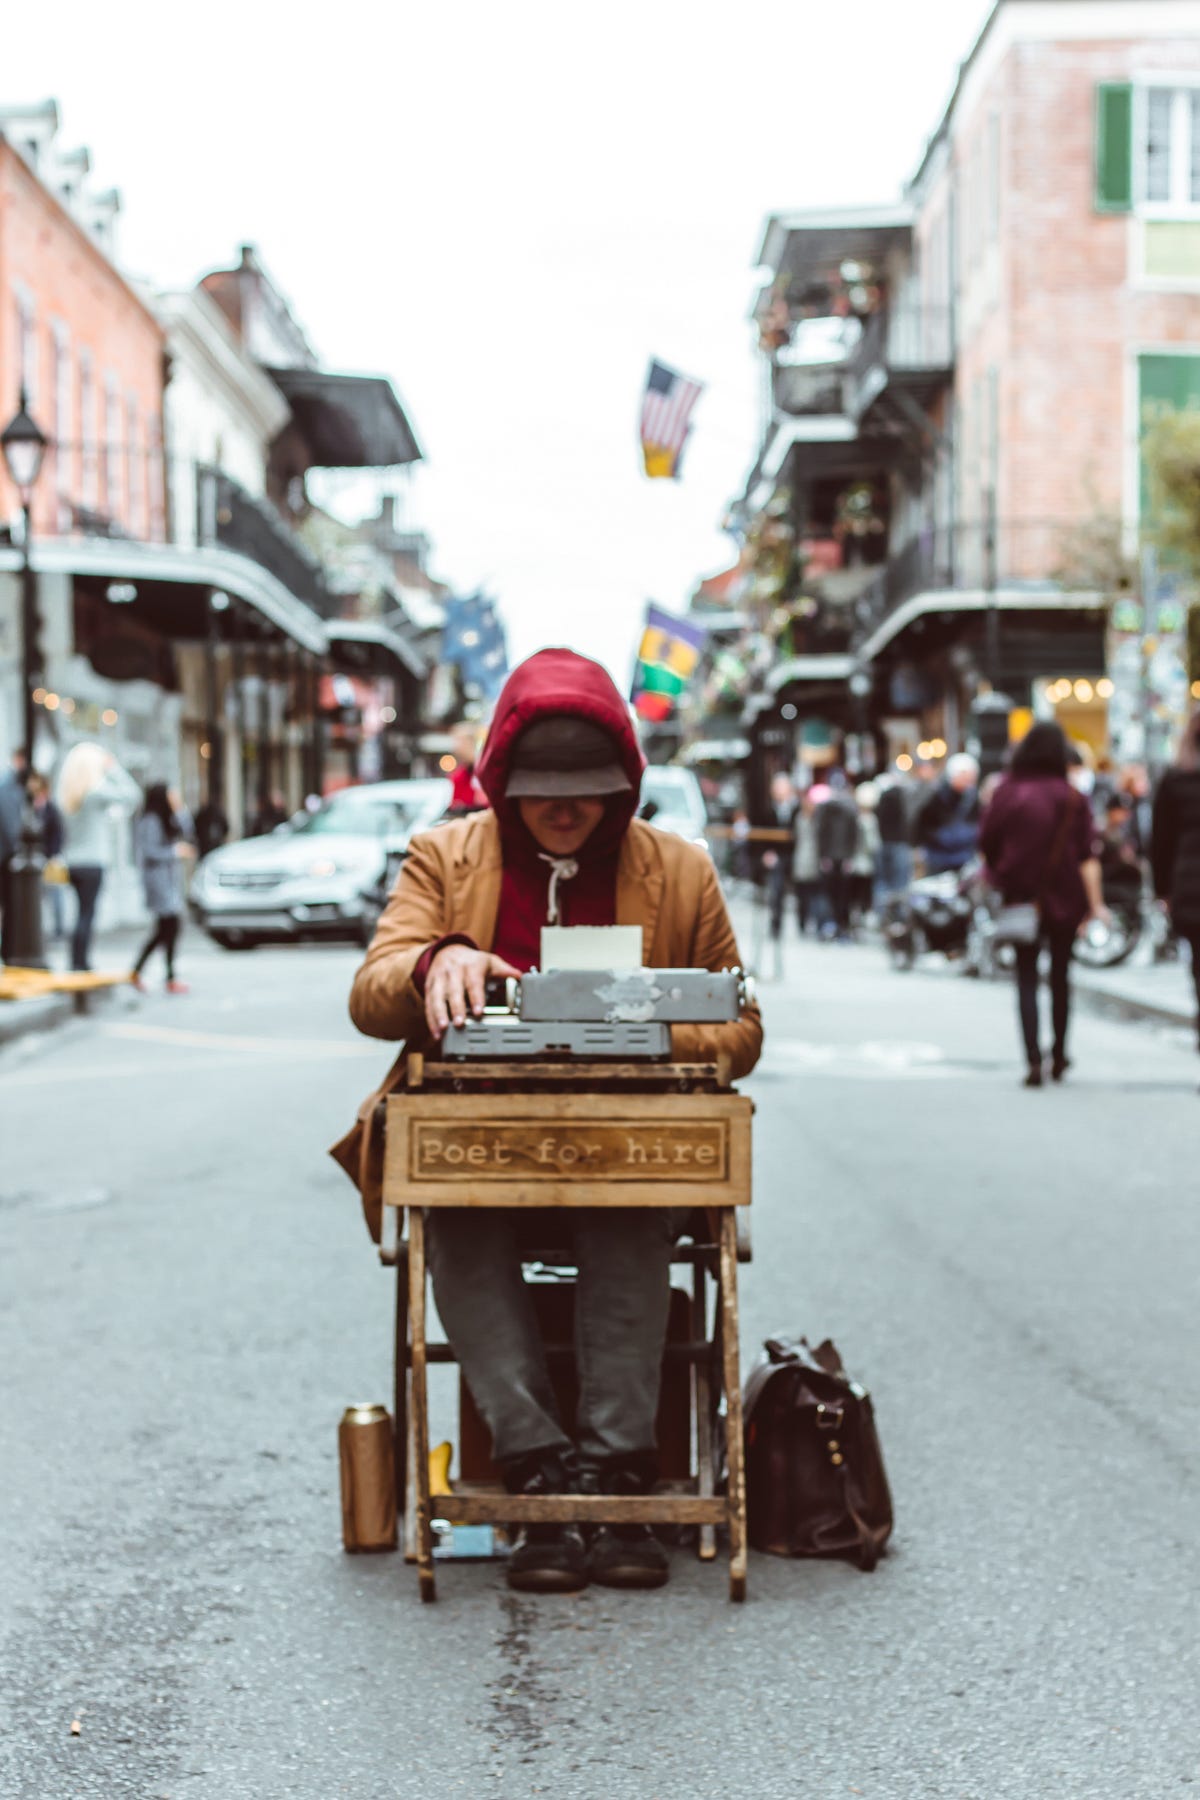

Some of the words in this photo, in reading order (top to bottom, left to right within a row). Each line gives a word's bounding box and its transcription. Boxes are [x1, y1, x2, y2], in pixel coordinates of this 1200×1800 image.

[421, 1138, 512, 1165] Poet
[537, 1138, 603, 1165] for
[626, 1137, 716, 1165] hire
